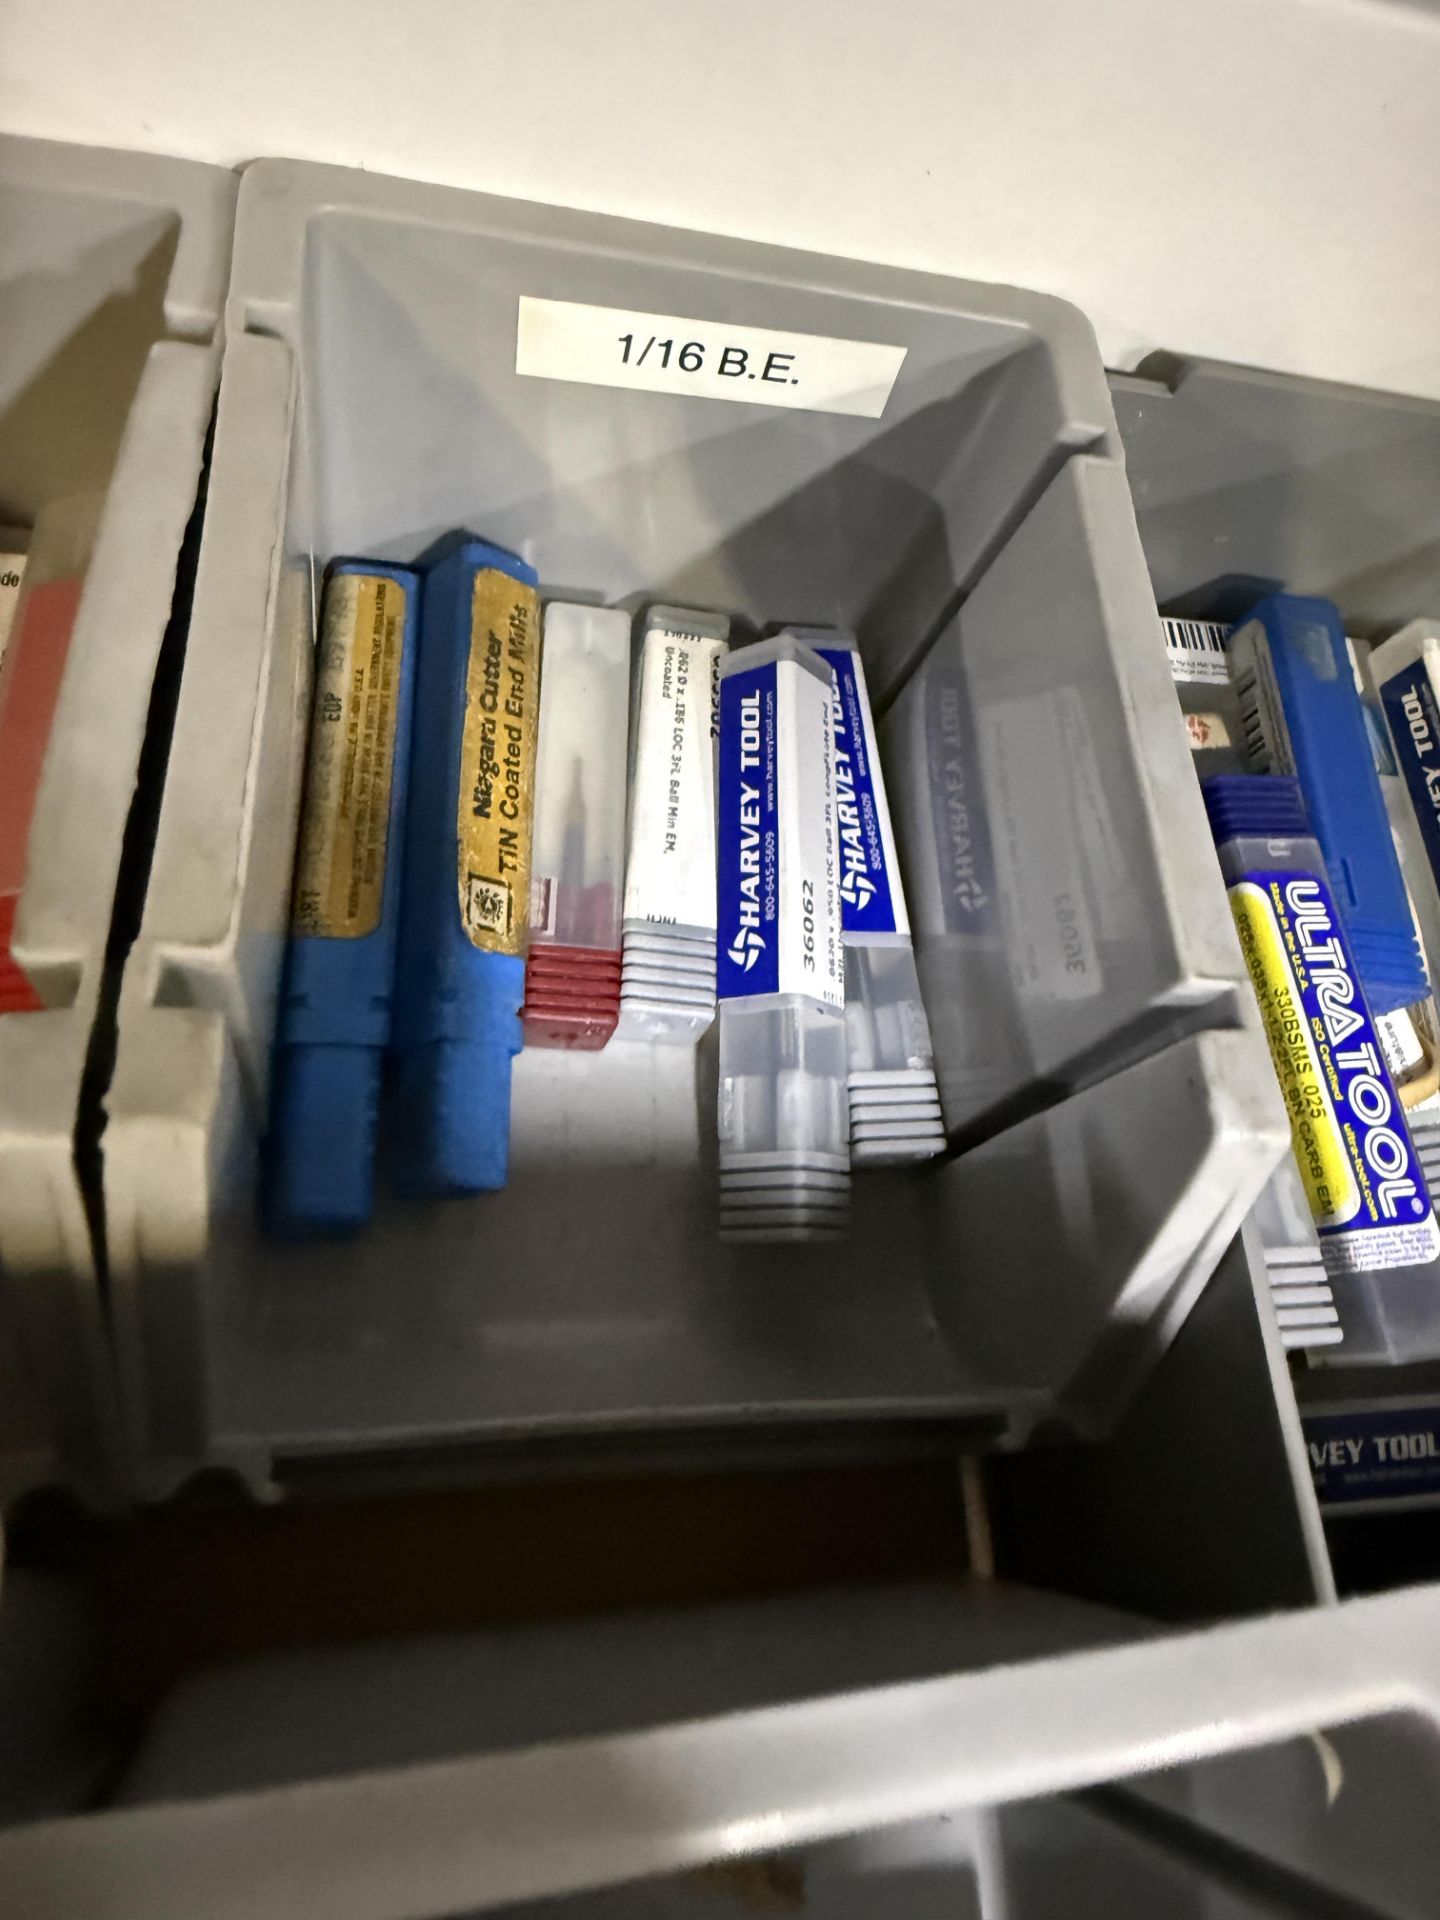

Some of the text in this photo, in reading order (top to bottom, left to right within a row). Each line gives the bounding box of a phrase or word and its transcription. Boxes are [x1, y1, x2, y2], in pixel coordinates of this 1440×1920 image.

[618, 333, 799, 385] 1/16 B.E.
[504, 667, 525, 718] End
[662, 646, 675, 700] Uncoated
[473, 628, 502, 819] Niagara Cutter
[672, 726, 684, 751] LOC
[1401, 683, 1434, 760] TOOL
[499, 723, 523, 821] Coated
[669, 779, 680, 804] Ball
[740, 689, 760, 928] HARVEY TOOL
[765, 691, 775, 921] 800-645-5609 www.harveytool.com
[836, 748, 868, 874] HARVEY
[803, 879, 815, 973] 36062
[1311, 1017, 1344, 1101] ISO Certified
[1298, 1119, 1324, 1178] CARB
[1316, 1184, 1336, 1217] EM
[1343, 1122, 1379, 1222] ultra-tool.com
[1372, 1431, 1440, 1462] TOOL
